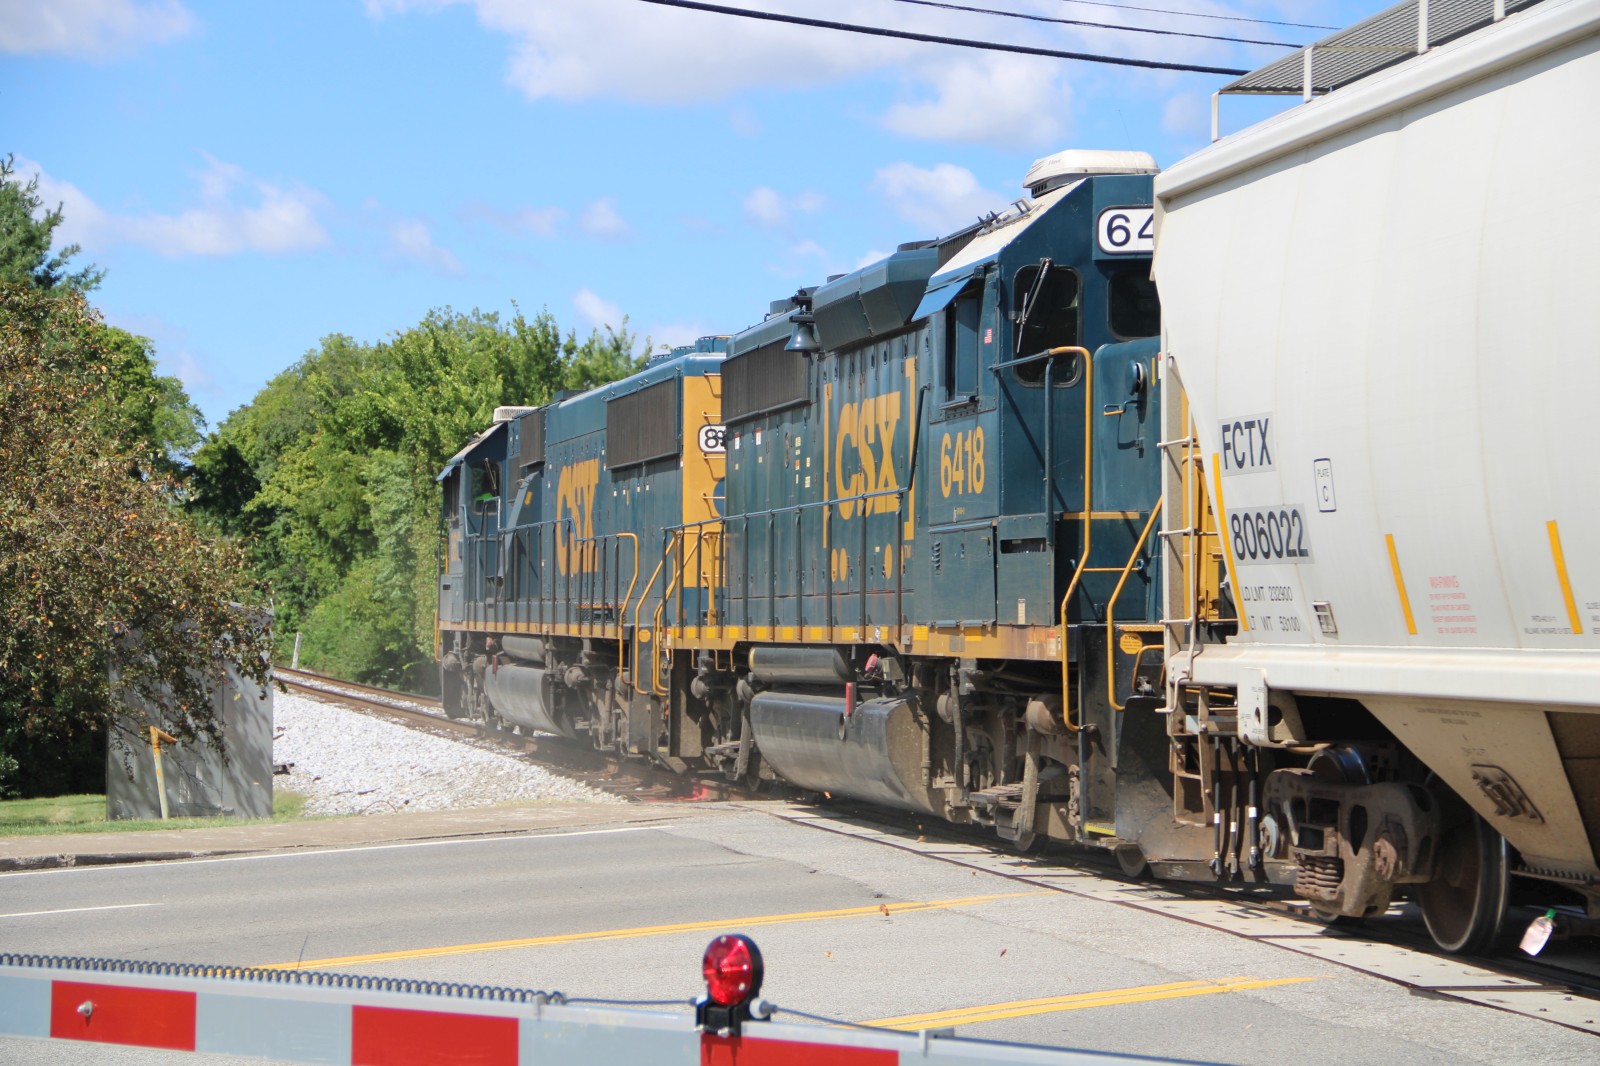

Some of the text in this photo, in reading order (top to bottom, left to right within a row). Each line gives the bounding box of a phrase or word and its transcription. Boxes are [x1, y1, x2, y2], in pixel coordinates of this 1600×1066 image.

[835, 391, 901, 521] CSX
[940, 425, 985, 498] 6418
[1221, 417, 1272, 470] FCTX
[556, 458, 599, 577] CSX
[1322, 485, 1329, 502] C
[1230, 508, 1309, 562] 806022
